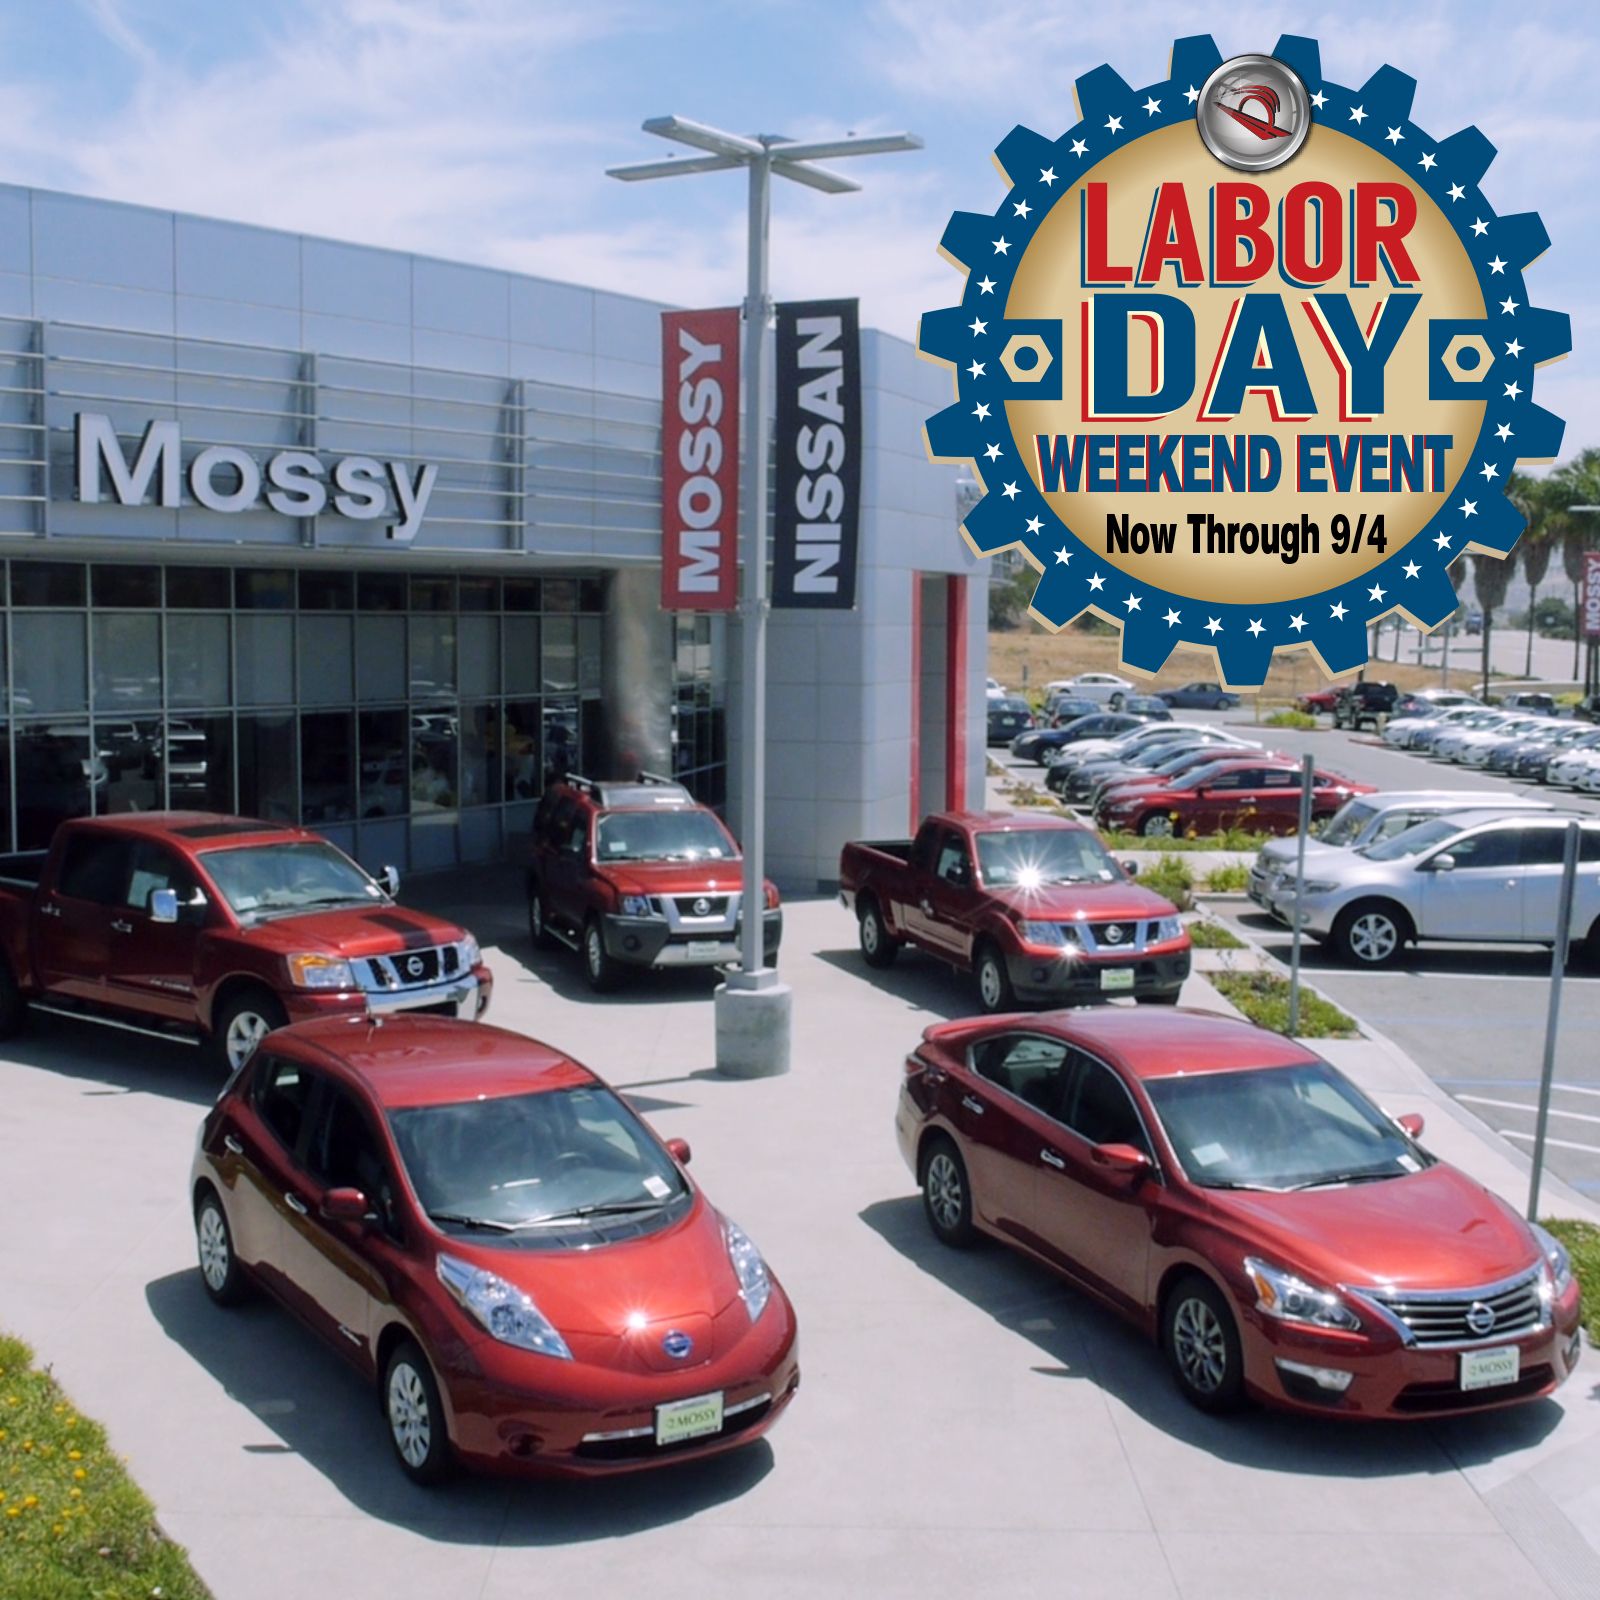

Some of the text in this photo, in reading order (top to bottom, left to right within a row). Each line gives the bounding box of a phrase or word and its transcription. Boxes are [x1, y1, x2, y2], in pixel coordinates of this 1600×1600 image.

[73, 412, 438, 540] Mossy
[678, 328, 723, 592] MOSSY
[793, 316, 846, 593] NISSAN
[1585, 557, 1600, 630] MOSSY
[1479, 1360, 1514, 1374] MOSSY
[677, 1408, 716, 1427] MOSSY
